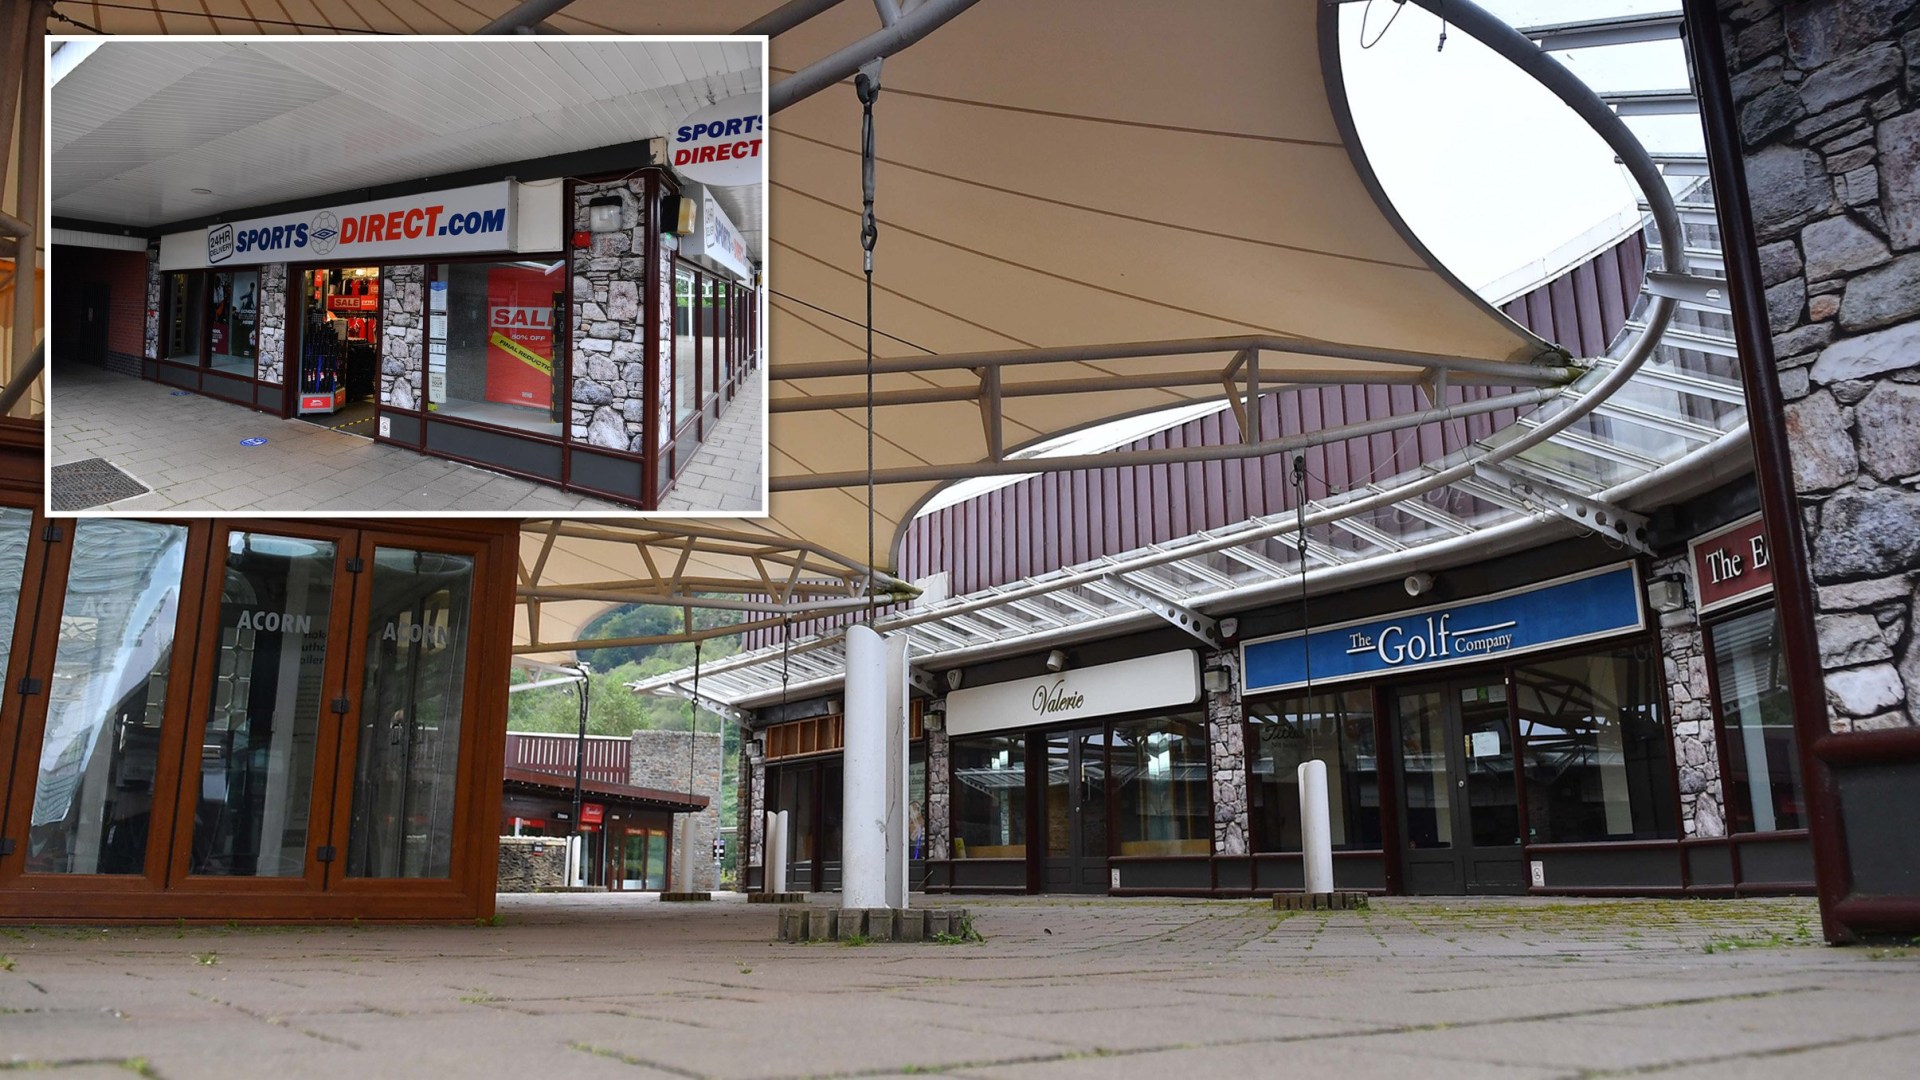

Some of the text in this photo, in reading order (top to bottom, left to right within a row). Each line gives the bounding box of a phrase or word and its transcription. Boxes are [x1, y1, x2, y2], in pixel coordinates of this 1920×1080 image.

[674, 139, 762, 166] DIRECT
[210, 230, 231, 248] 24HR
[236, 222, 308, 252] SPORTS
[210, 243, 232, 257] DELIVERY
[334, 298, 359, 307] SALE
[499, 339, 518, 354] FINAL
[1706, 535, 1769, 583] The E
[237, 610, 311, 634] ACORN
[382, 622, 451, 645] ACORN
[1350, 613, 1512, 664] The Golf Company
[1032, 679, 1083, 716] Valerie
